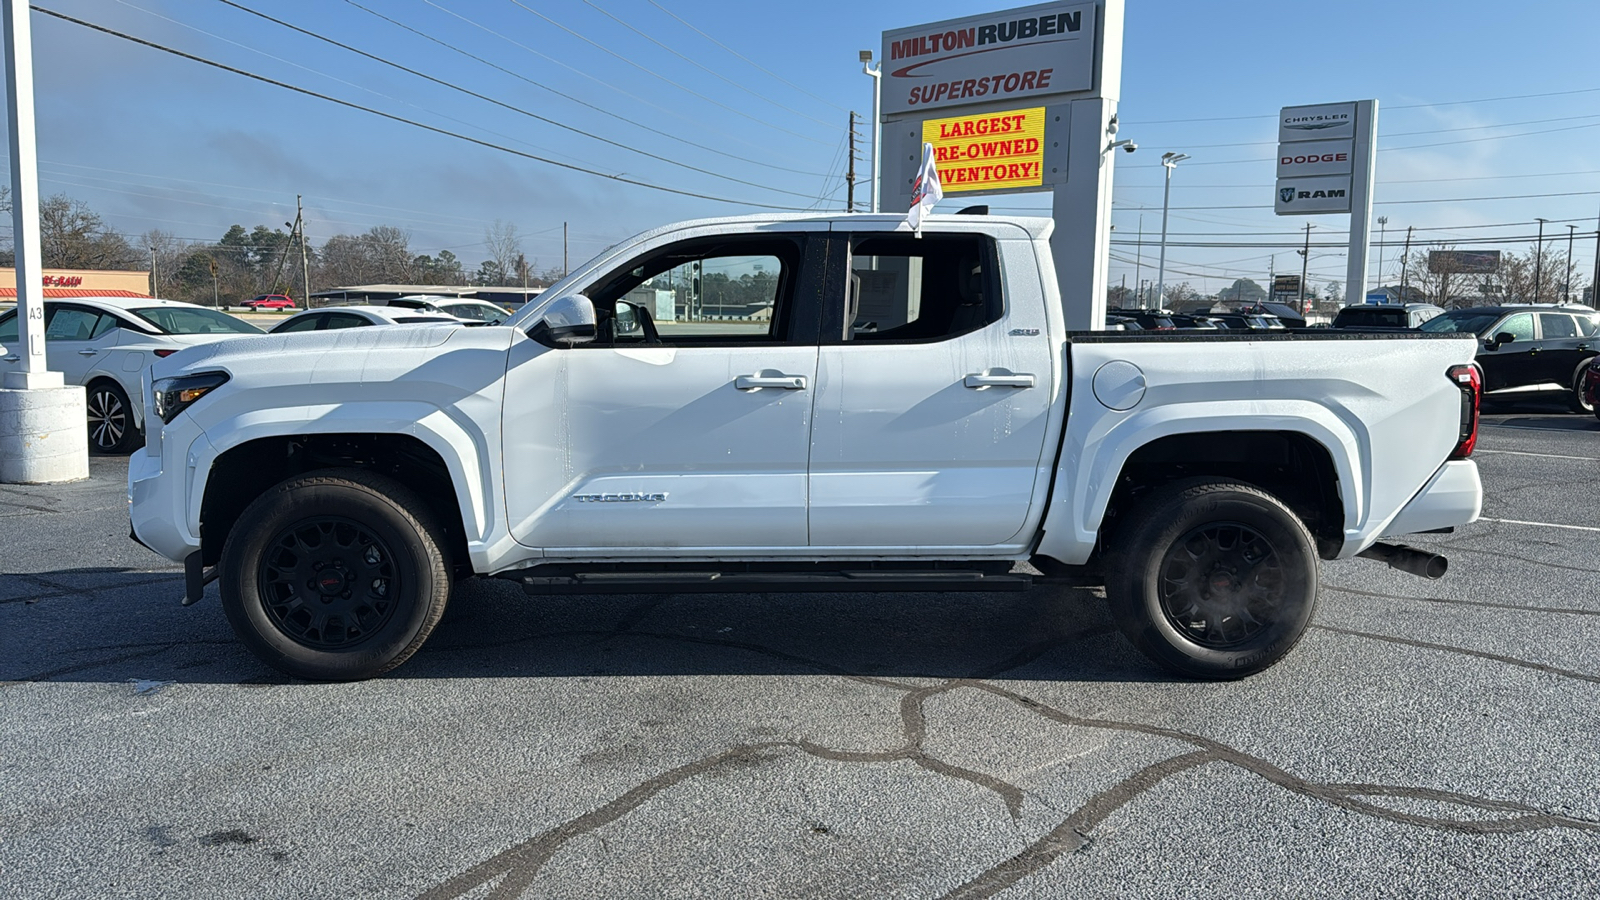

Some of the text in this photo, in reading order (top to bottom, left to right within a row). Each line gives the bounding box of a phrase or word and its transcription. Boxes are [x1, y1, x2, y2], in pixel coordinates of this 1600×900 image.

[908, 68, 1053, 105] SUPERSTORE
[1284, 114, 1348, 124] CHRYSLER
[940, 114, 1025, 138] LARGEST
[1281, 153, 1348, 165] DODGE
[1297, 189, 1346, 199] RAM
[29, 307, 42, 320] A3
[573, 492, 668, 503] TACOMA
